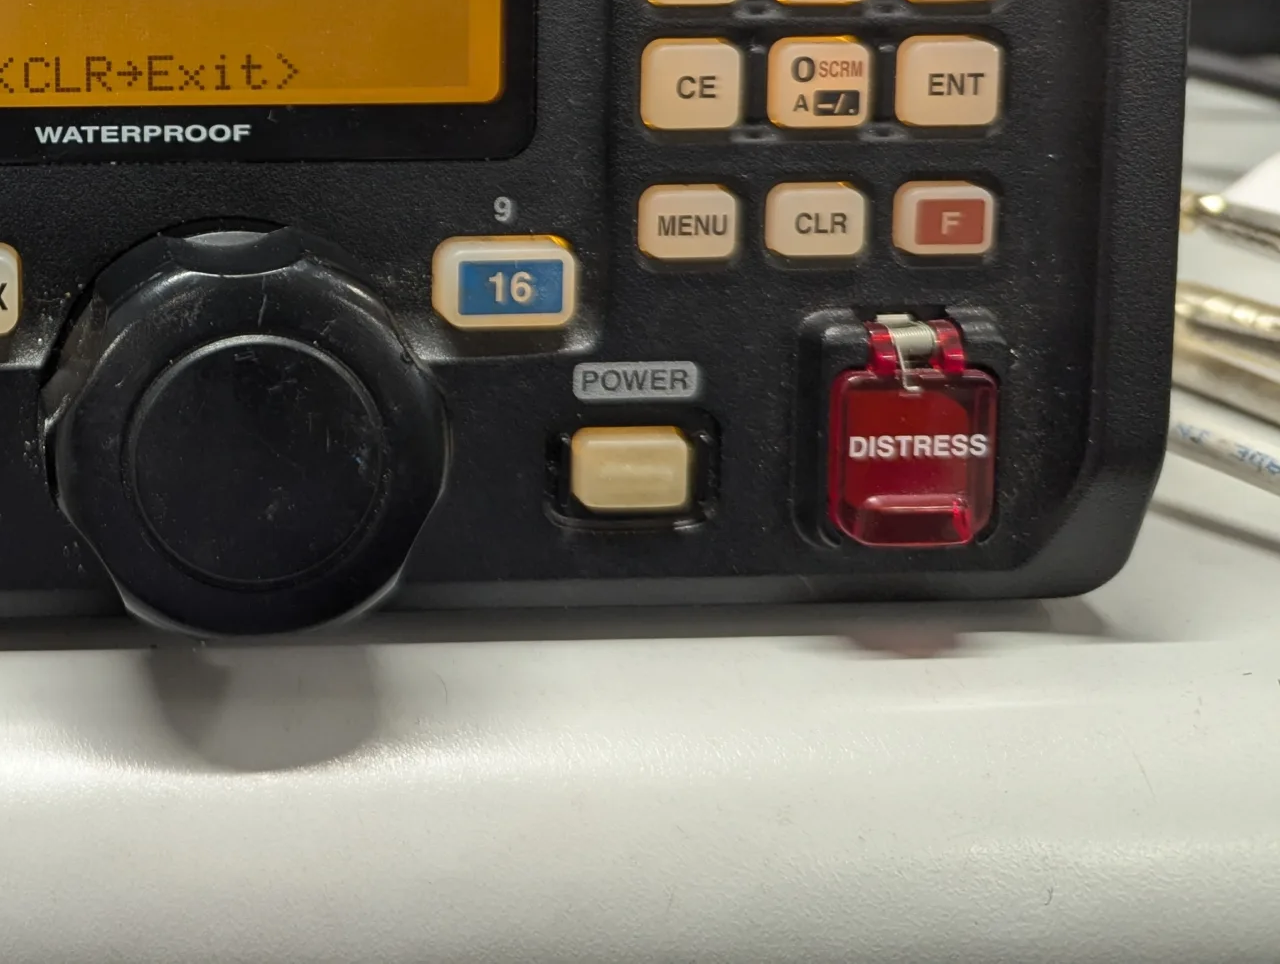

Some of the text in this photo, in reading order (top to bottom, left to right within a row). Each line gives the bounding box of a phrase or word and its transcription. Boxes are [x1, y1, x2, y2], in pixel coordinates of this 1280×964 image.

[818, 59, 864, 79] SCRM
[676, 75, 717, 100] CE
[927, 72, 985, 97] ENT
[34, 124, 252, 144] WATERPROOF
[493, 196, 513, 223] 9
[657, 214, 729, 237] MENU
[794, 212, 848, 235] CLR
[940, 211, 962, 235] F
[488, 271, 534, 303] 16
[581, 368, 689, 393] POWER
[848, 433, 989, 459] DISTRESS
